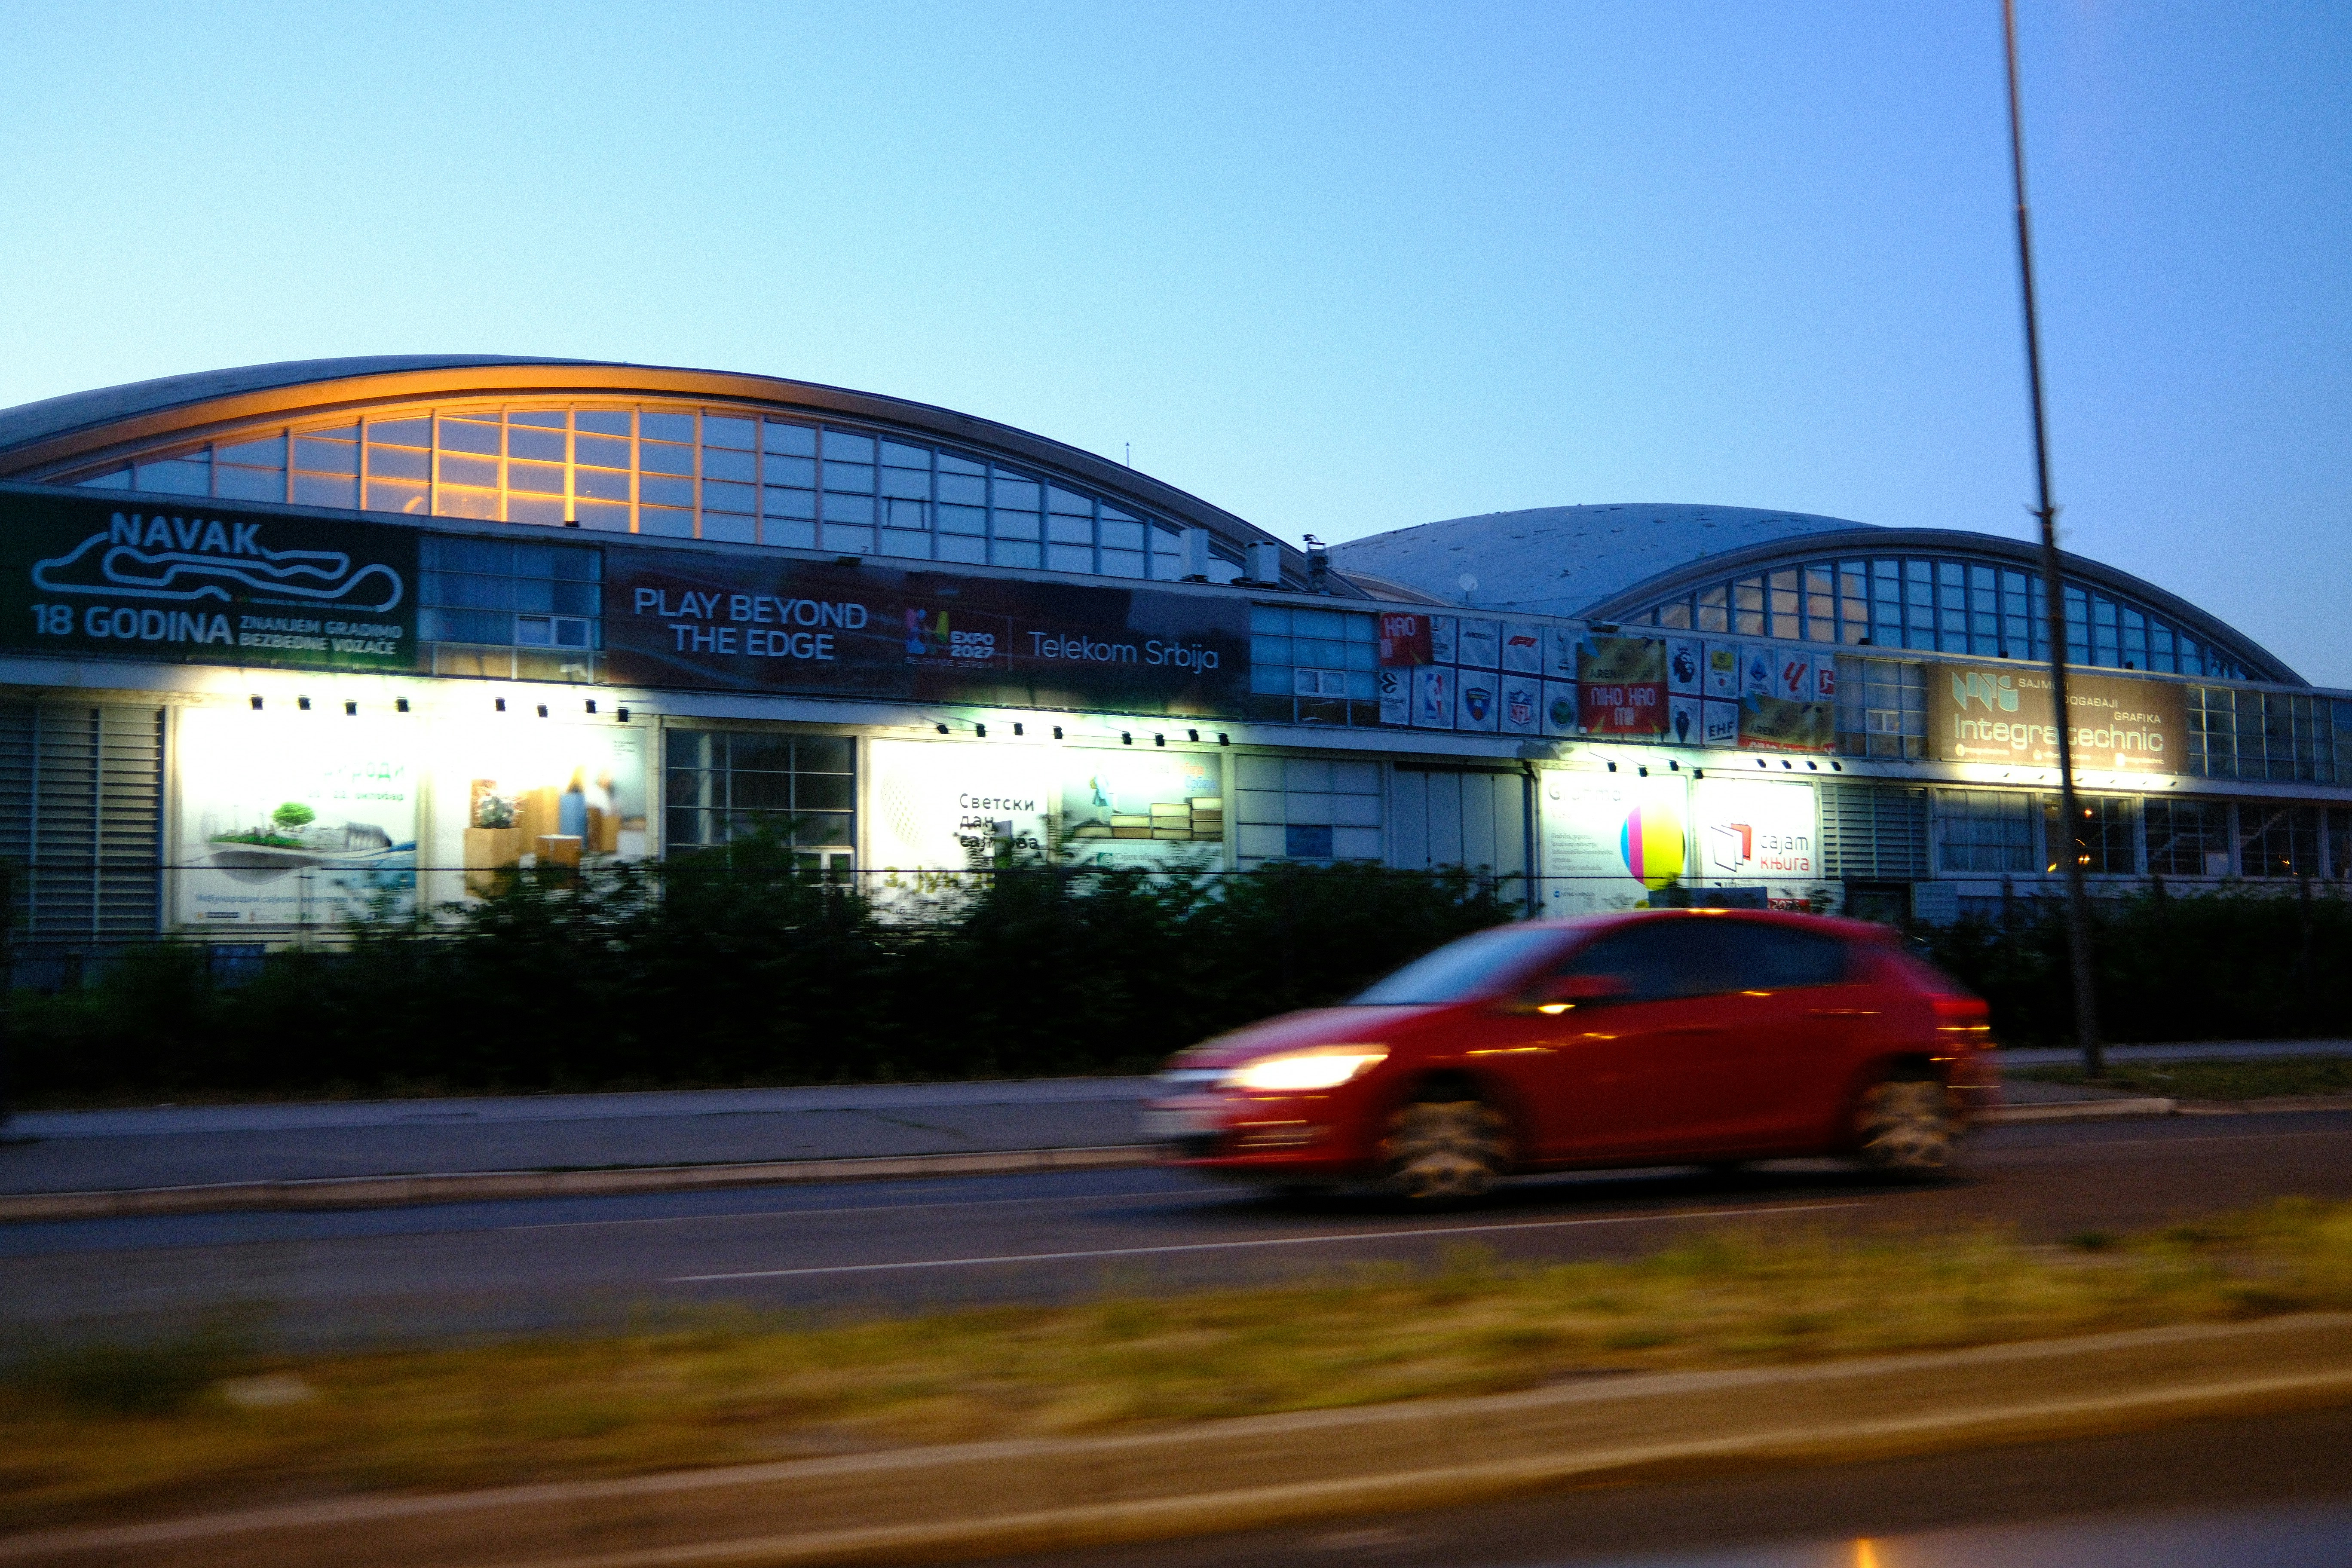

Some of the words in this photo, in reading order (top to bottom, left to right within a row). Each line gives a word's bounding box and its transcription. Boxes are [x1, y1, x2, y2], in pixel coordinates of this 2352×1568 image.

[110, 512, 262, 555] NAVAK
[634, 588, 722, 619] PLAY
[730, 594, 868, 629] BEYOND
[31, 603, 73, 635] 18
[84, 605, 234, 645] GODINA
[324, 621, 403, 639] GRADIMO
[668, 624, 737, 654] THE
[747, 629, 834, 660] EDGE
[950, 631, 995, 646] EXPO
[950, 644, 995, 659] 2027
[1028, 631, 1138, 663] Telekom
[1145, 640, 1219, 674] Srbija
[2018, 678, 2069, 690] SAJMI
[2114, 711, 2161, 723] GRAFIKA
[1709, 721, 1734, 737] EHF
[960, 793, 1034, 811] Светски
[959, 816, 993, 830] дан
[1761, 836, 1809, 854] сајам
